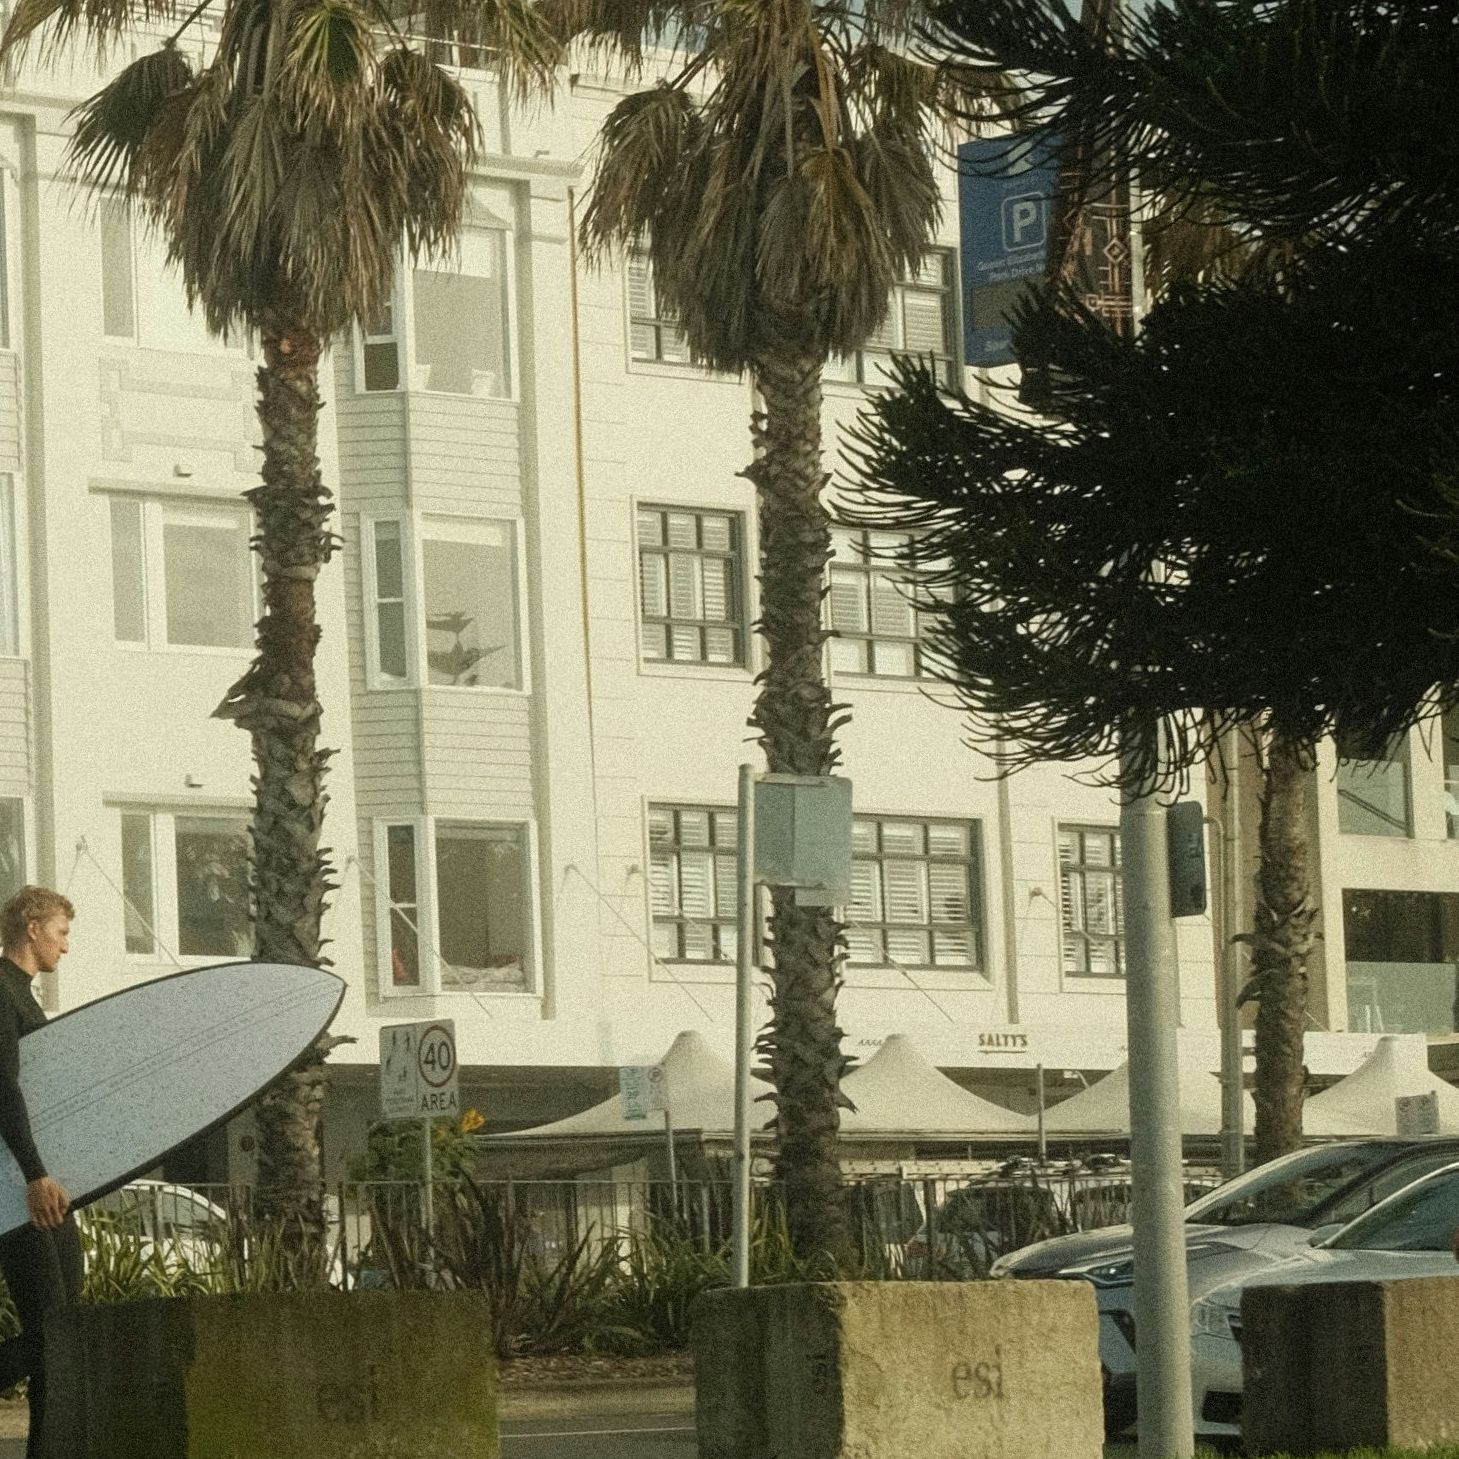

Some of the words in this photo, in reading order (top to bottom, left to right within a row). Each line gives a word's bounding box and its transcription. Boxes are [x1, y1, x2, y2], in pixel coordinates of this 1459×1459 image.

[1012, 200, 1037, 243] P
[423, 1041, 451, 1071] 40
[421, 1091, 458, 1111] AREA
[951, 1343, 1005, 1400] esi
